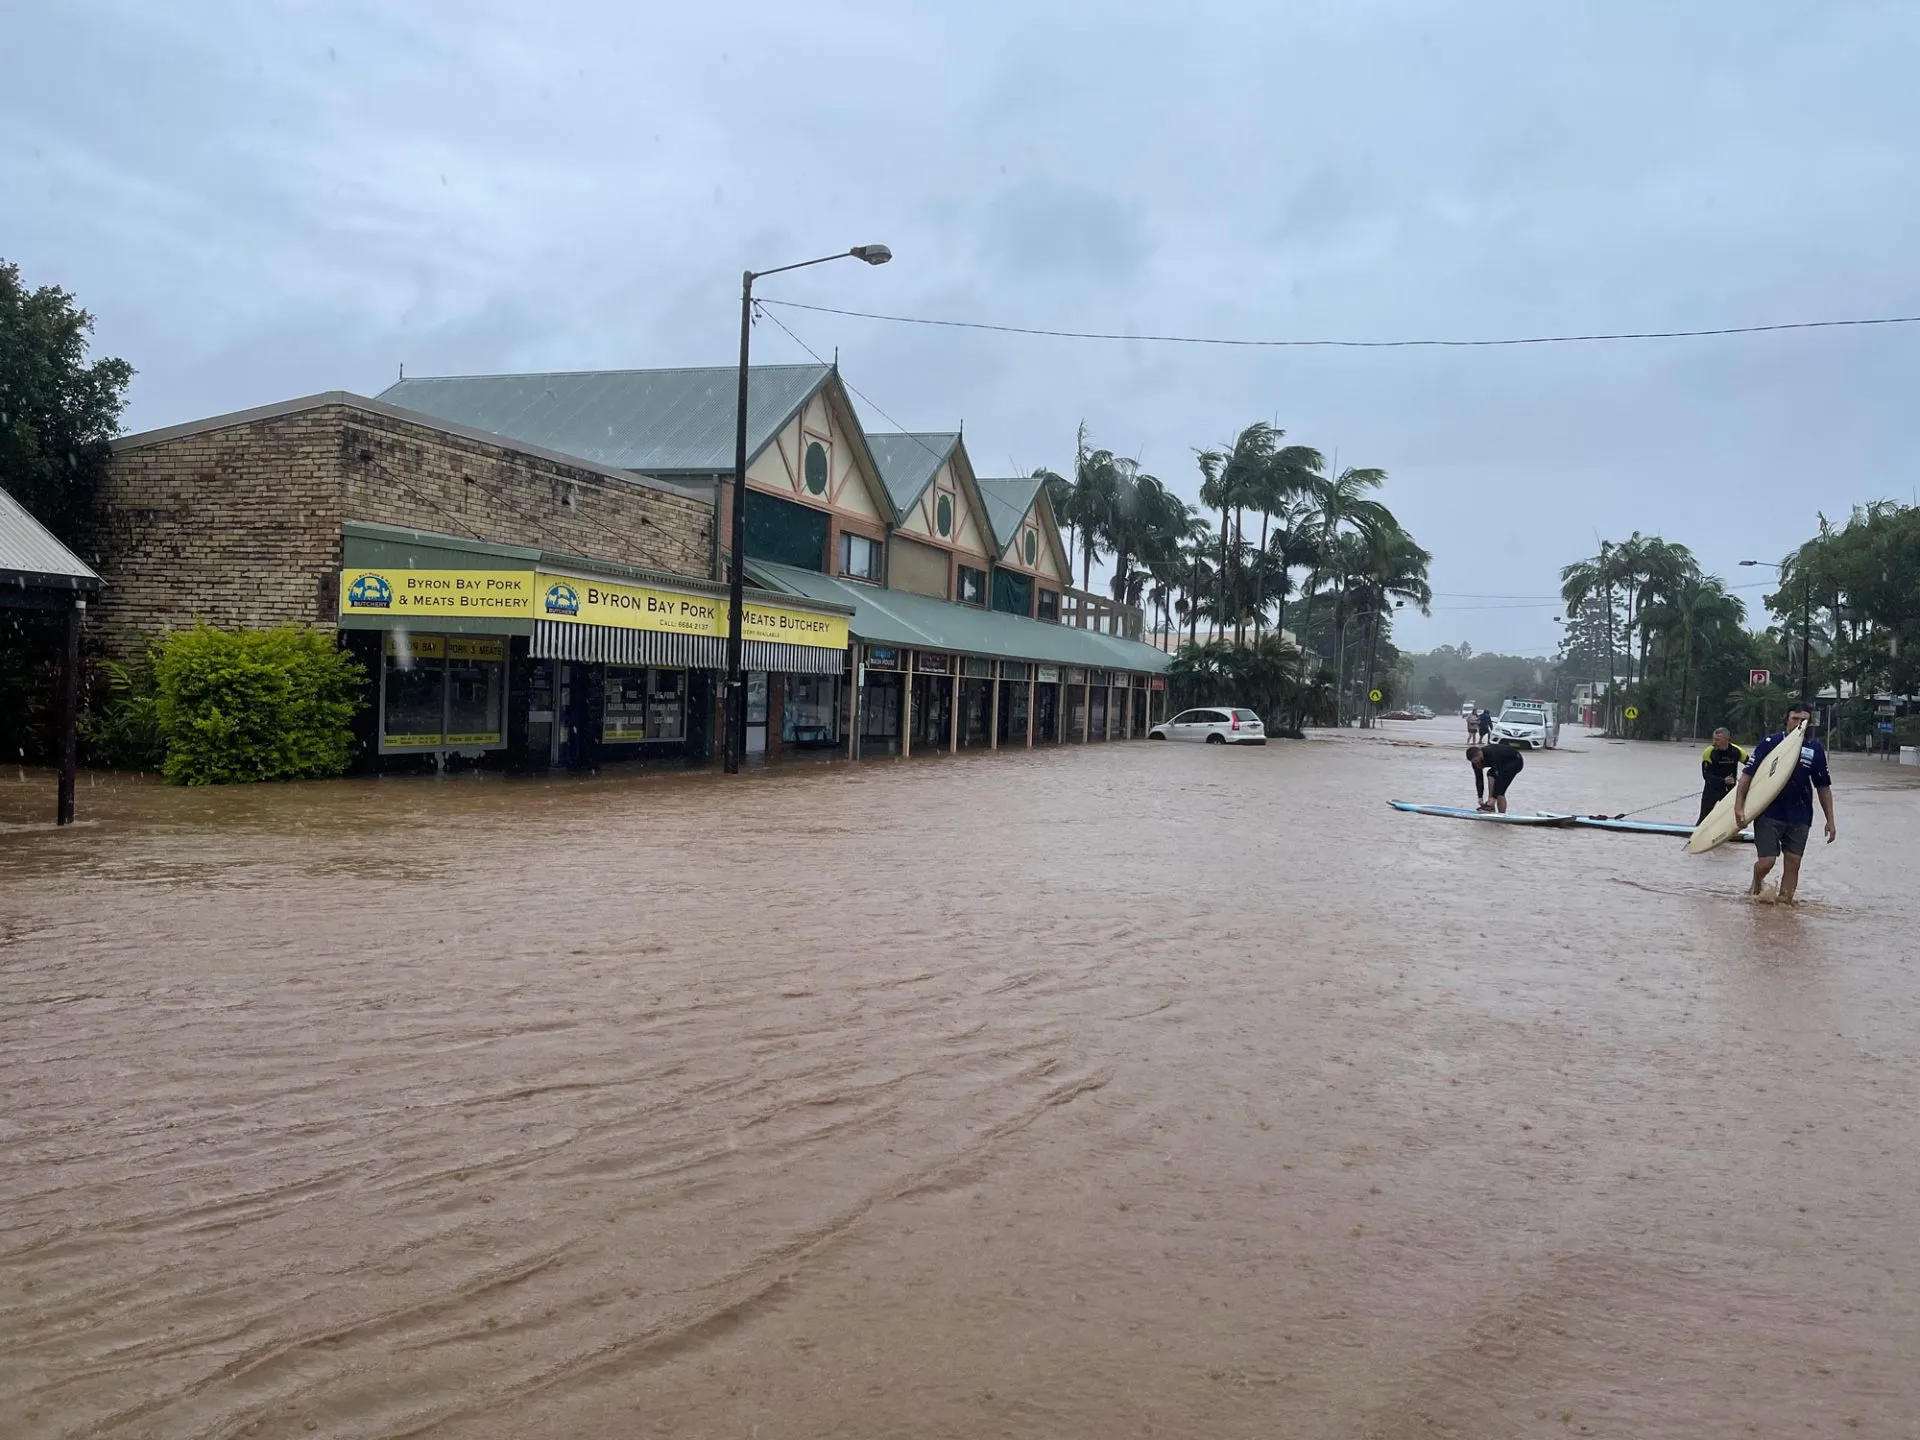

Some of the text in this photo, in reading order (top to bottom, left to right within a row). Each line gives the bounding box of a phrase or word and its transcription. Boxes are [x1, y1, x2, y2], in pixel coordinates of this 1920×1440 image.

[407, 578, 450, 589] BYRON
[456, 579, 481, 589] BAY
[486, 579, 521, 590] PORK
[398, 595, 529, 607] & MEATS BUTCHERY
[588, 588, 641, 610] BYRON
[647, 597, 675, 614] BAY
[680, 601, 715, 619] PORK
[741, 611, 776, 627] MEATS
[780, 615, 830, 633] BUTCHERY
[423, 642, 437, 653] BAY
